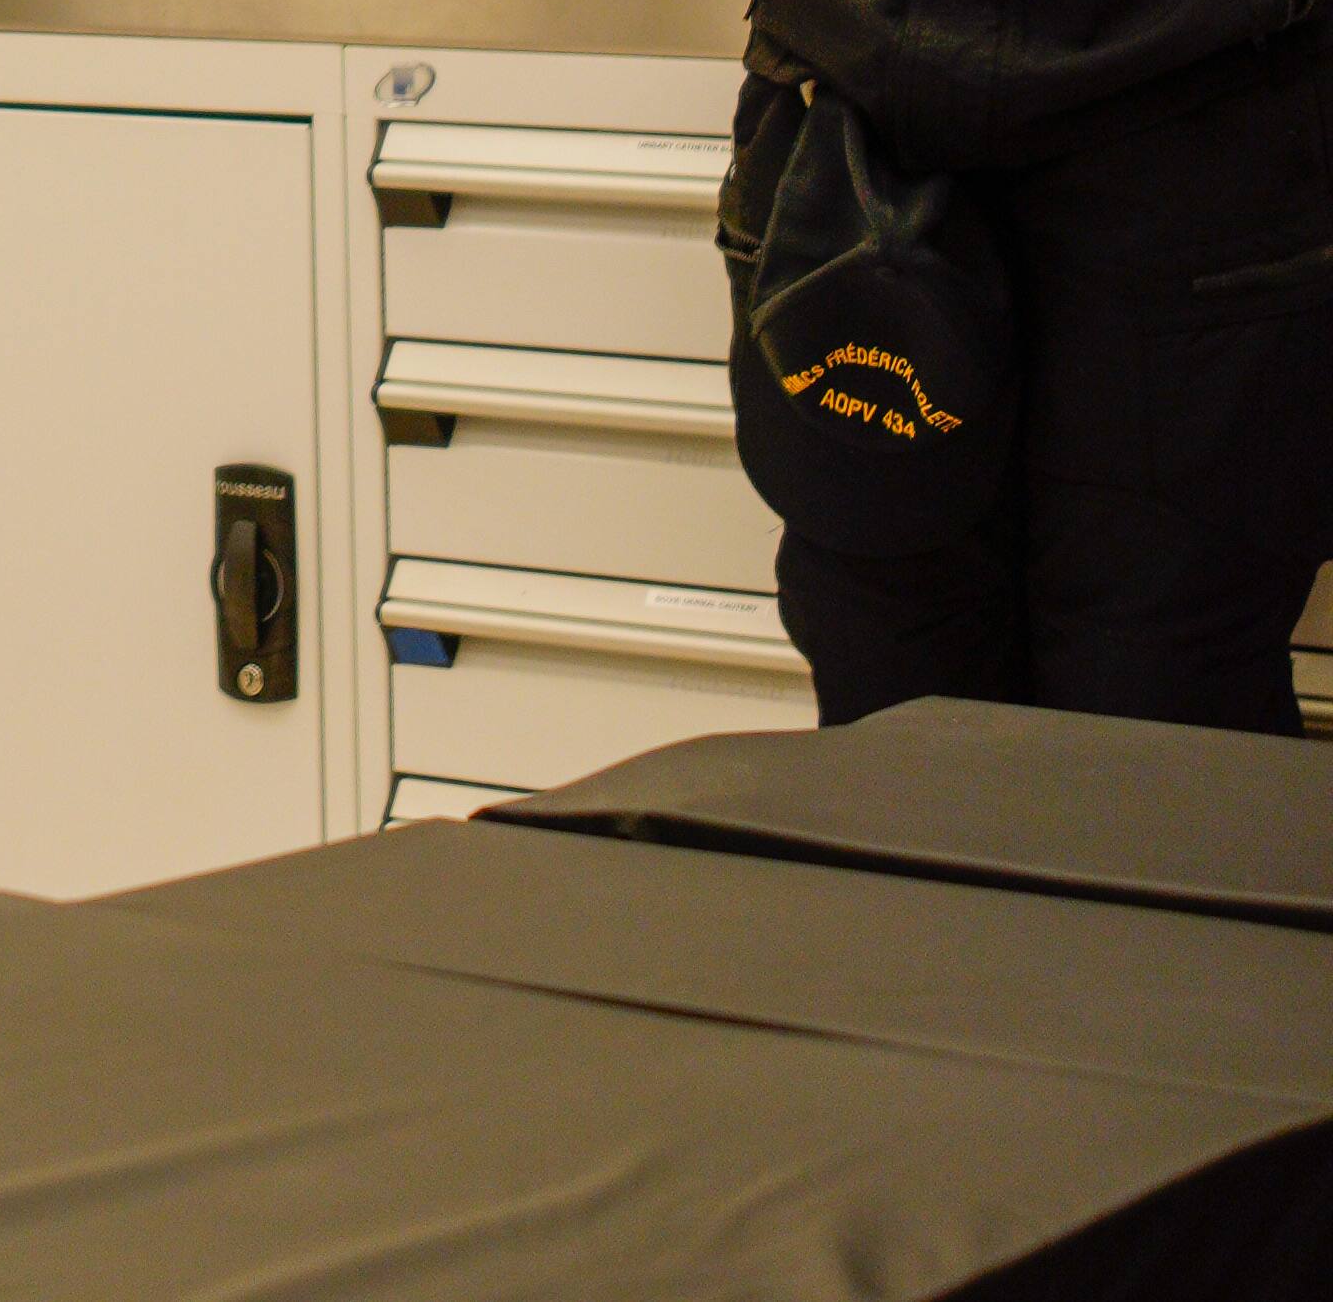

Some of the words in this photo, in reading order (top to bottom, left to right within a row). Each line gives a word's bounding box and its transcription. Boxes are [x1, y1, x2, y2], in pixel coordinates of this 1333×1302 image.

[825, 341, 915, 385] FRÉDÉRICK
[820, 387, 878, 424] AOPV
[882, 408, 916, 441] 434
